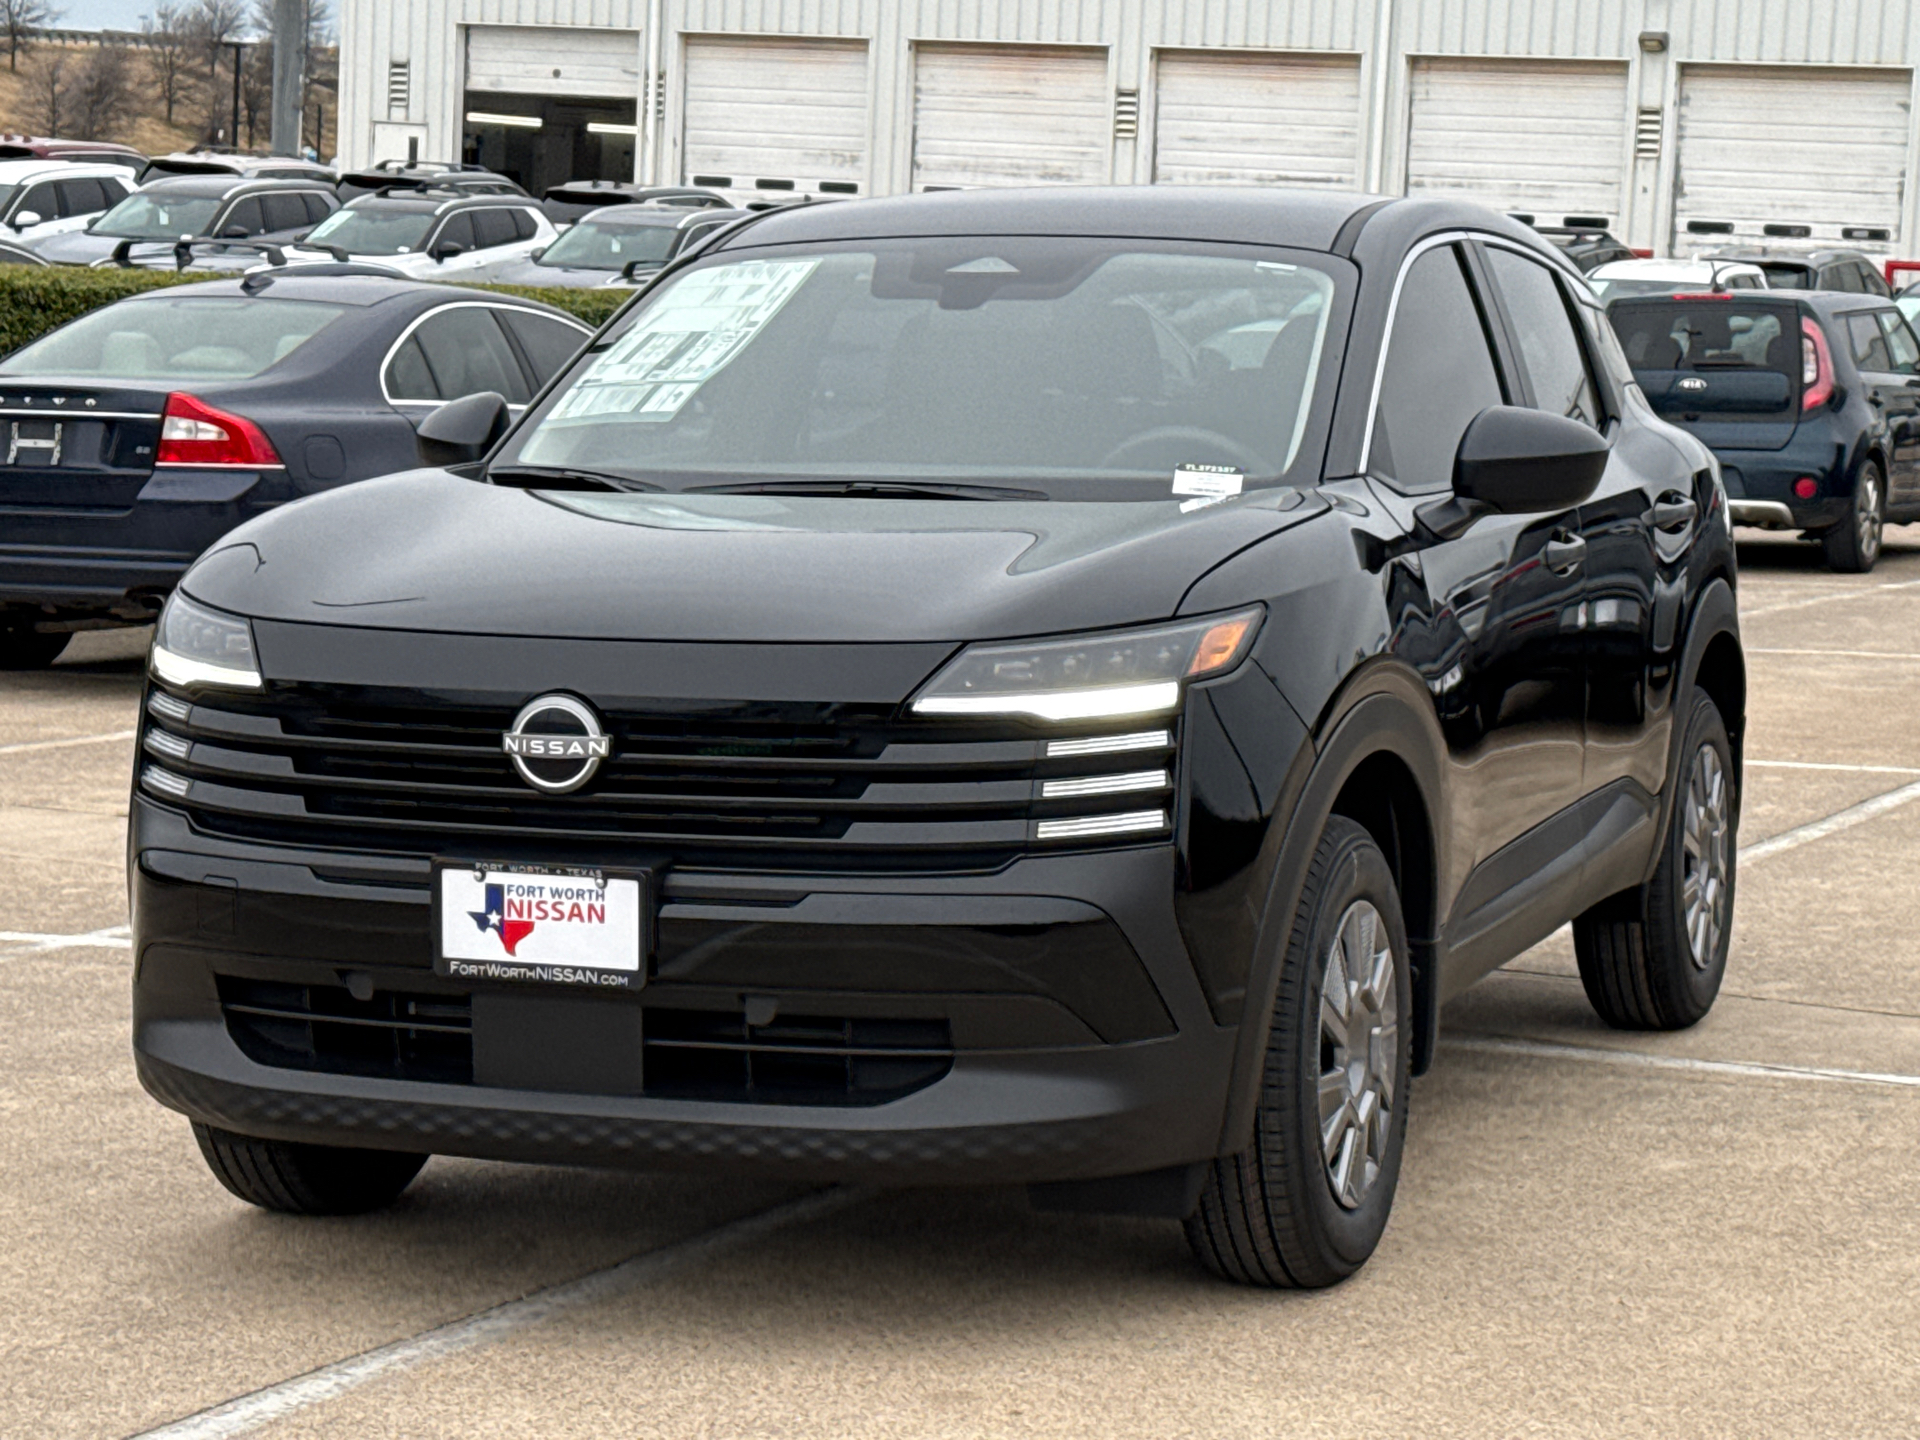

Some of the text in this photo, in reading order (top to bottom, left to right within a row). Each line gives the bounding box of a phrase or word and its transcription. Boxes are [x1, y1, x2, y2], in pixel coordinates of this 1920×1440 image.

[504, 736, 606, 755] NISSAN
[475, 862, 602, 878] FORT WORTH TEXAS
[506, 884, 605, 902] FORT WORTH
[507, 898, 605, 924] NISSAN
